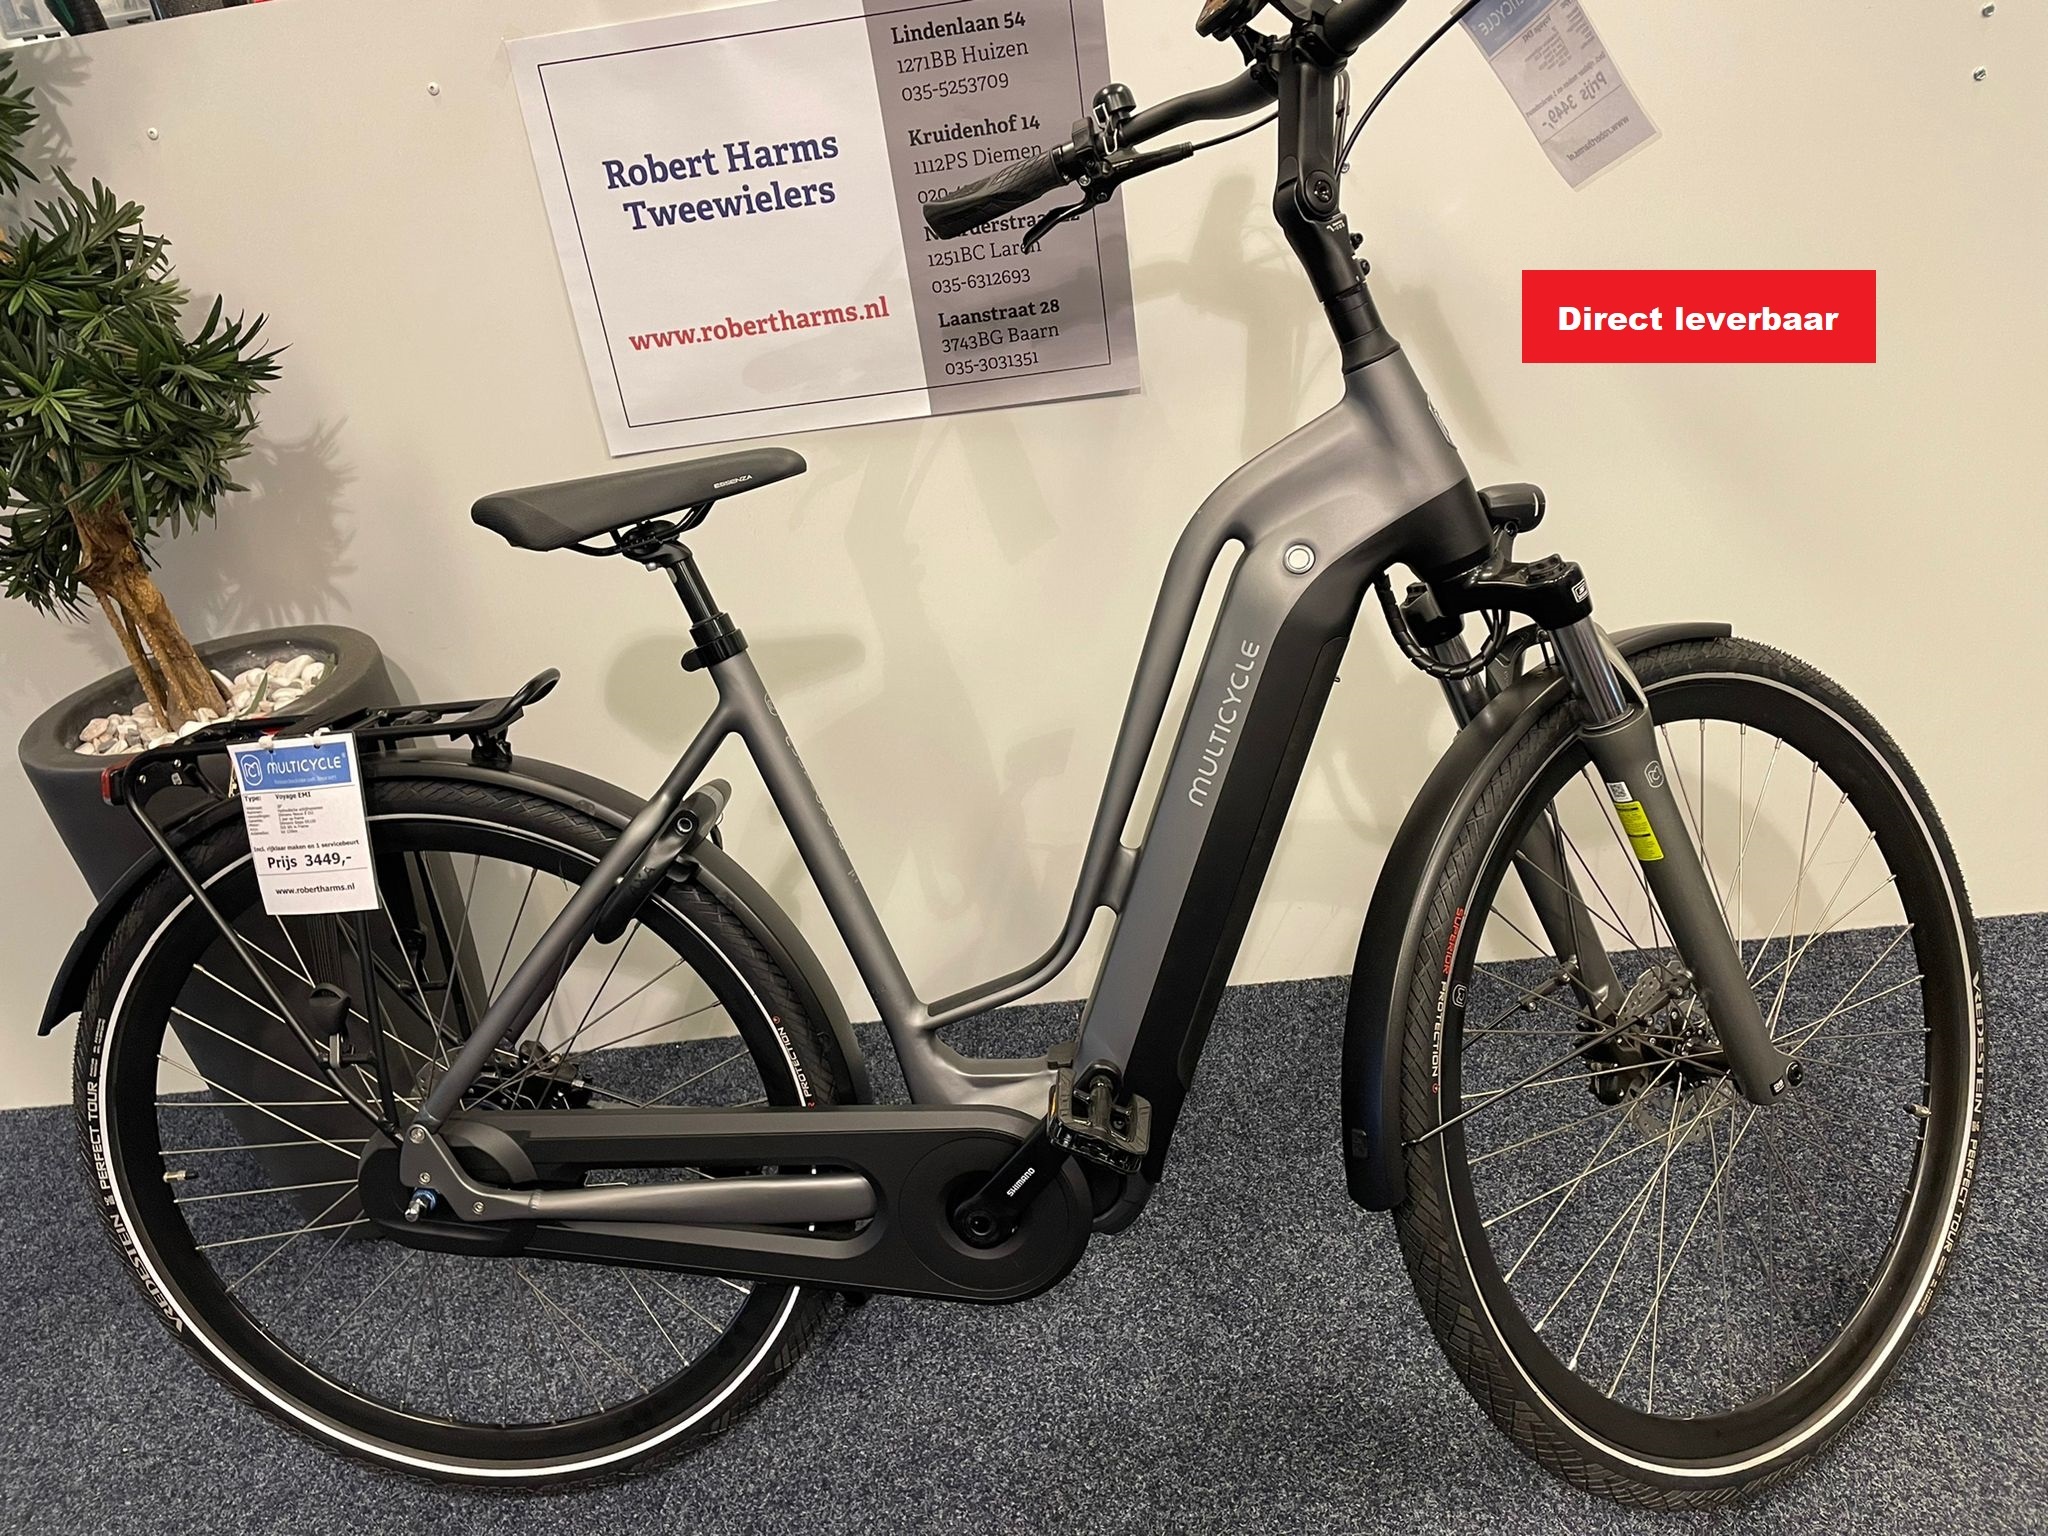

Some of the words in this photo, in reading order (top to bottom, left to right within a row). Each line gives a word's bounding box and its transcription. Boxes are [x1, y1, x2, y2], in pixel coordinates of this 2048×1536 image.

[891, 17, 999, 44] Lindenlaan
[1004, 11, 1026, 29] 54
[897, 49, 957, 73] 1271BB
[961, 42, 1029, 64] Huizen
[901, 73, 1009, 101] 035-5253709
[908, 114, 1018, 146] Kruidenhof
[1021, 115, 1041, 130] 14
[602, 148, 719, 189] Robert
[723, 135, 839, 172] Harms
[914, 152, 968, 175] 1112PS
[973, 145, 1042, 167] Diemen
[623, 180, 836, 230] Tweewielers
[928, 244, 985, 267] 1251BC
[931, 268, 1031, 293] 035-6312693
[628, 296, 890, 350] www.robertharms.nl
[938, 302, 1037, 328] Laanstraat
[1040, 298, 1060, 313] 28
[941, 329, 1003, 353] 3743BG
[1007, 325, 1060, 343] Baarn
[945, 351, 1039, 376] 035-3031351
[1188, 640, 1260, 807] MULTICYCLE
[267, 756, 342, 775] MULTICYCLE
[267, 856, 298, 871] Prijs
[304, 852, 352, 867] 3449,-
[275, 883, 356, 895] www.robertharms.nl
[1431, 980, 1448, 1077] PROTECTION
[777, 1026, 812, 1098] PROTECTION
[86, 1081, 98, 1122] TOUR
[90, 1124, 111, 1190] PERFECT
[1006, 1167, 1036, 1197] SHIMANO
[1959, 1138, 1979, 1210] PERFECT
[1942, 1210, 1963, 1252] TOUR
